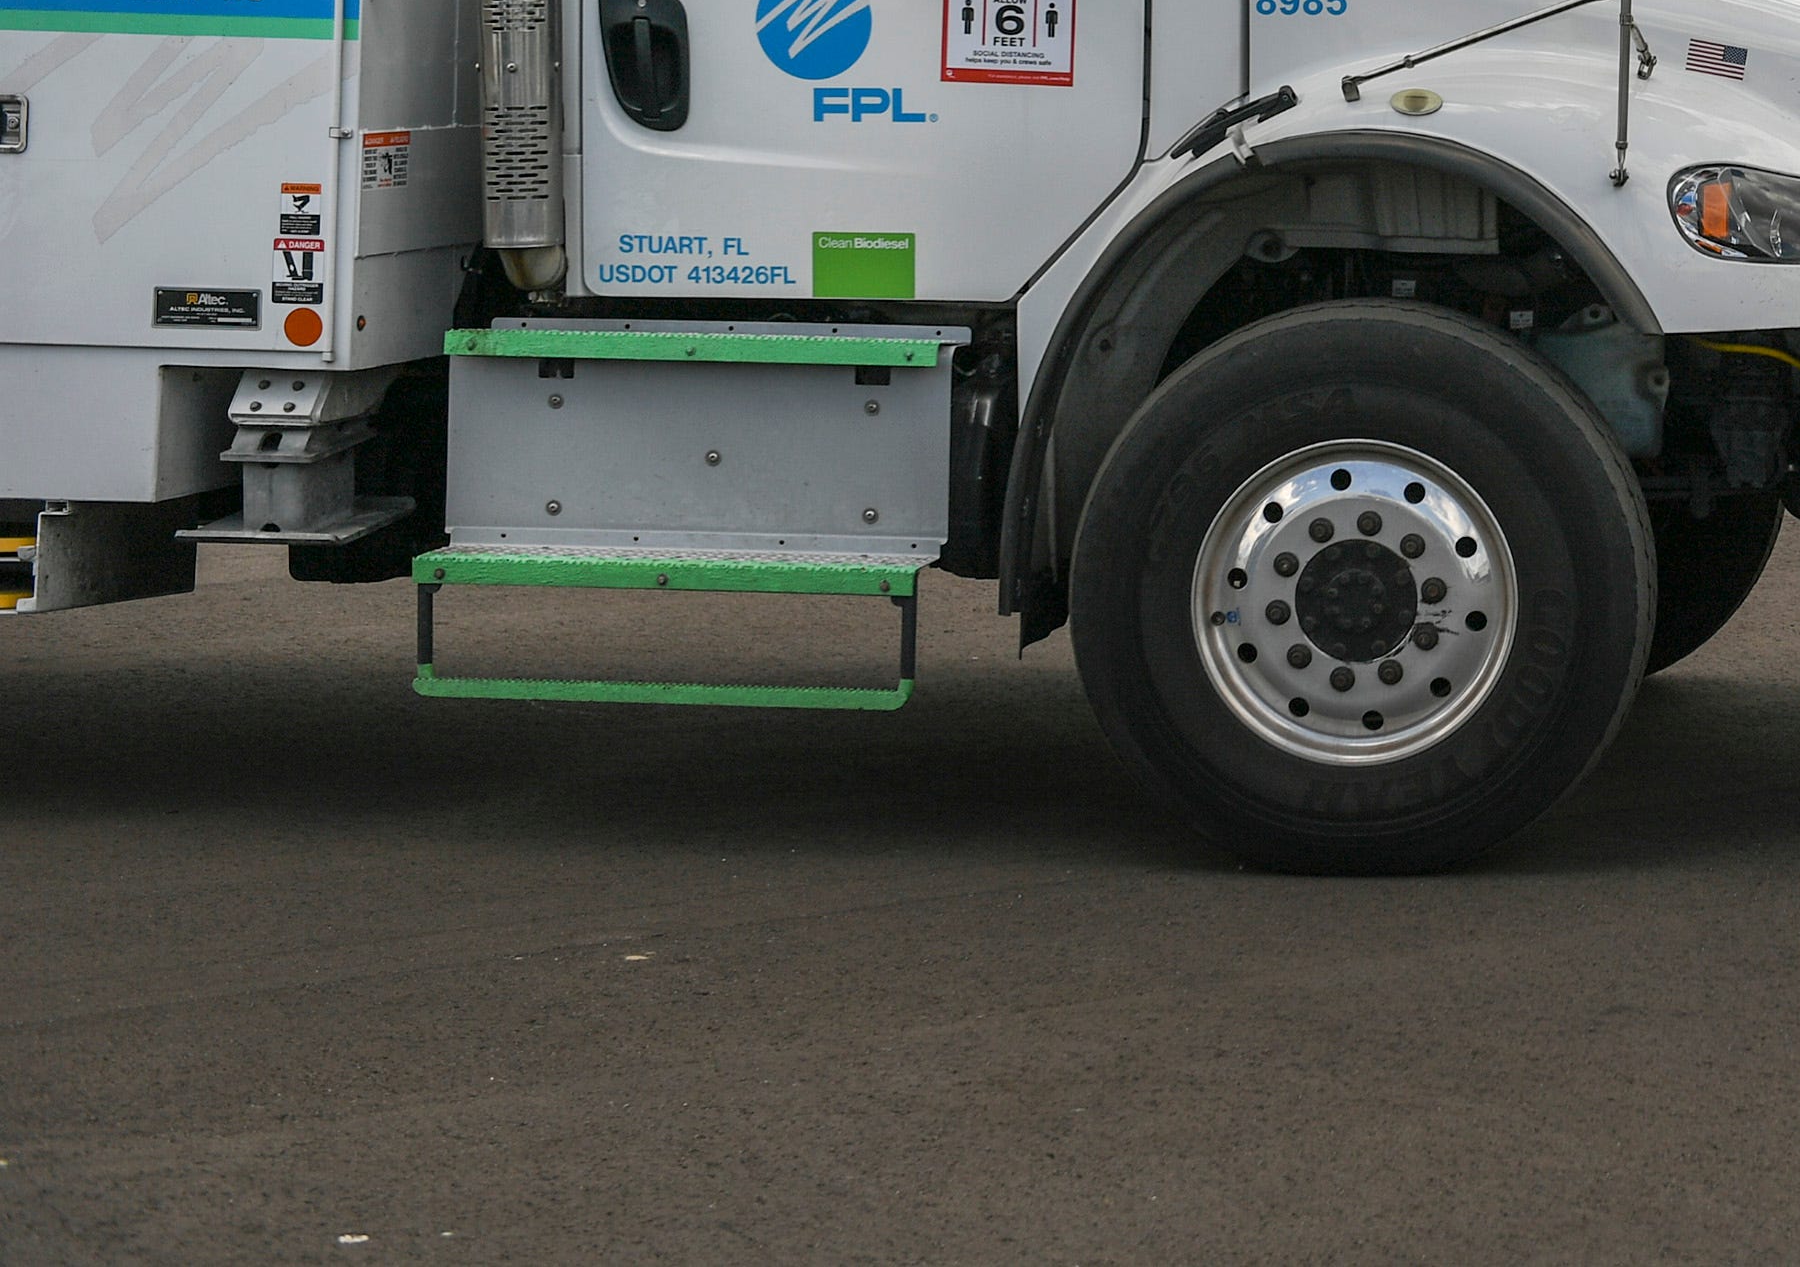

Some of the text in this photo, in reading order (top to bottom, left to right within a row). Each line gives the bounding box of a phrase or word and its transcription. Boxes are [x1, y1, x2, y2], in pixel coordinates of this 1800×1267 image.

[995, 5, 1025, 36] 6
[993, 37, 1026, 47] FEET
[813, 87, 927, 123] FPL
[288, 241, 321, 250] DANGER
[619, 234, 750, 259] STUART, FL
[818, 236, 909, 250] Clean Biodiesel
[599, 264, 797, 284] USDOT 413426FL
